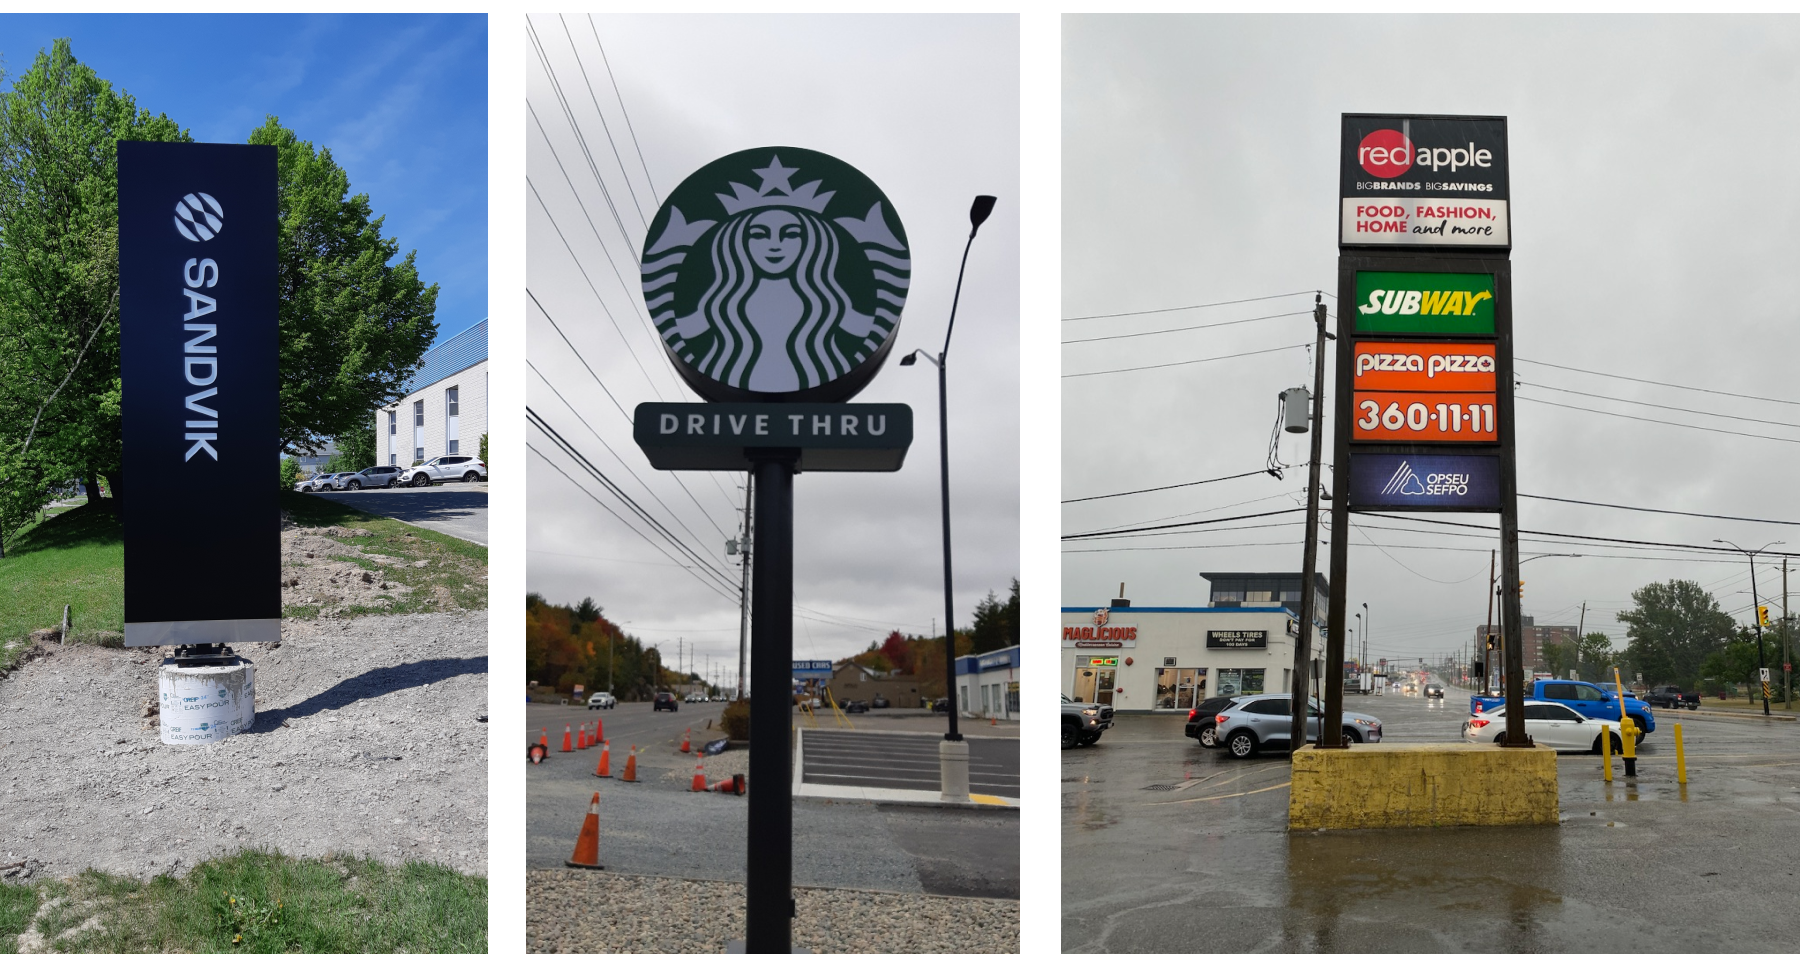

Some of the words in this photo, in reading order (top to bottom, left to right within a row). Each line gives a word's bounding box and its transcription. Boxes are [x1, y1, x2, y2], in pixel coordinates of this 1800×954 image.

[1359, 136, 1410, 166] red
[1416, 142, 1492, 172] apple
[1356, 181, 1421, 190] BIGBRANDS
[1425, 182, 1493, 192] BIGSAVINGS
[1356, 205, 1411, 220] FOOD,
[1416, 206, 1497, 221] FASHION,
[1356, 220, 1407, 233] HOME
[1412, 219, 1447, 236] and
[1451, 224, 1493, 236] more
[1359, 289, 1492, 316] SUBWAY
[183, 257, 219, 463] SANDVIK
[1356, 353, 1424, 377] pizza
[1427, 355, 1496, 378] pizza
[660, 413, 769, 435] DRIVE
[788, 414, 887, 436] THRU
[1426, 473, 1470, 485] OPSEU
[1426, 484, 1468, 496] SEFPO
[1062, 626, 1137, 641] MAGLICIOUS
[1242, 631, 1263, 639] TIRES
[792, 661, 811, 669] USED
[811, 661, 831, 669] CARS
[184, 703, 206, 711] EASY
[206, 699, 230, 709] POUR
[188, 733, 213, 741] POUR
